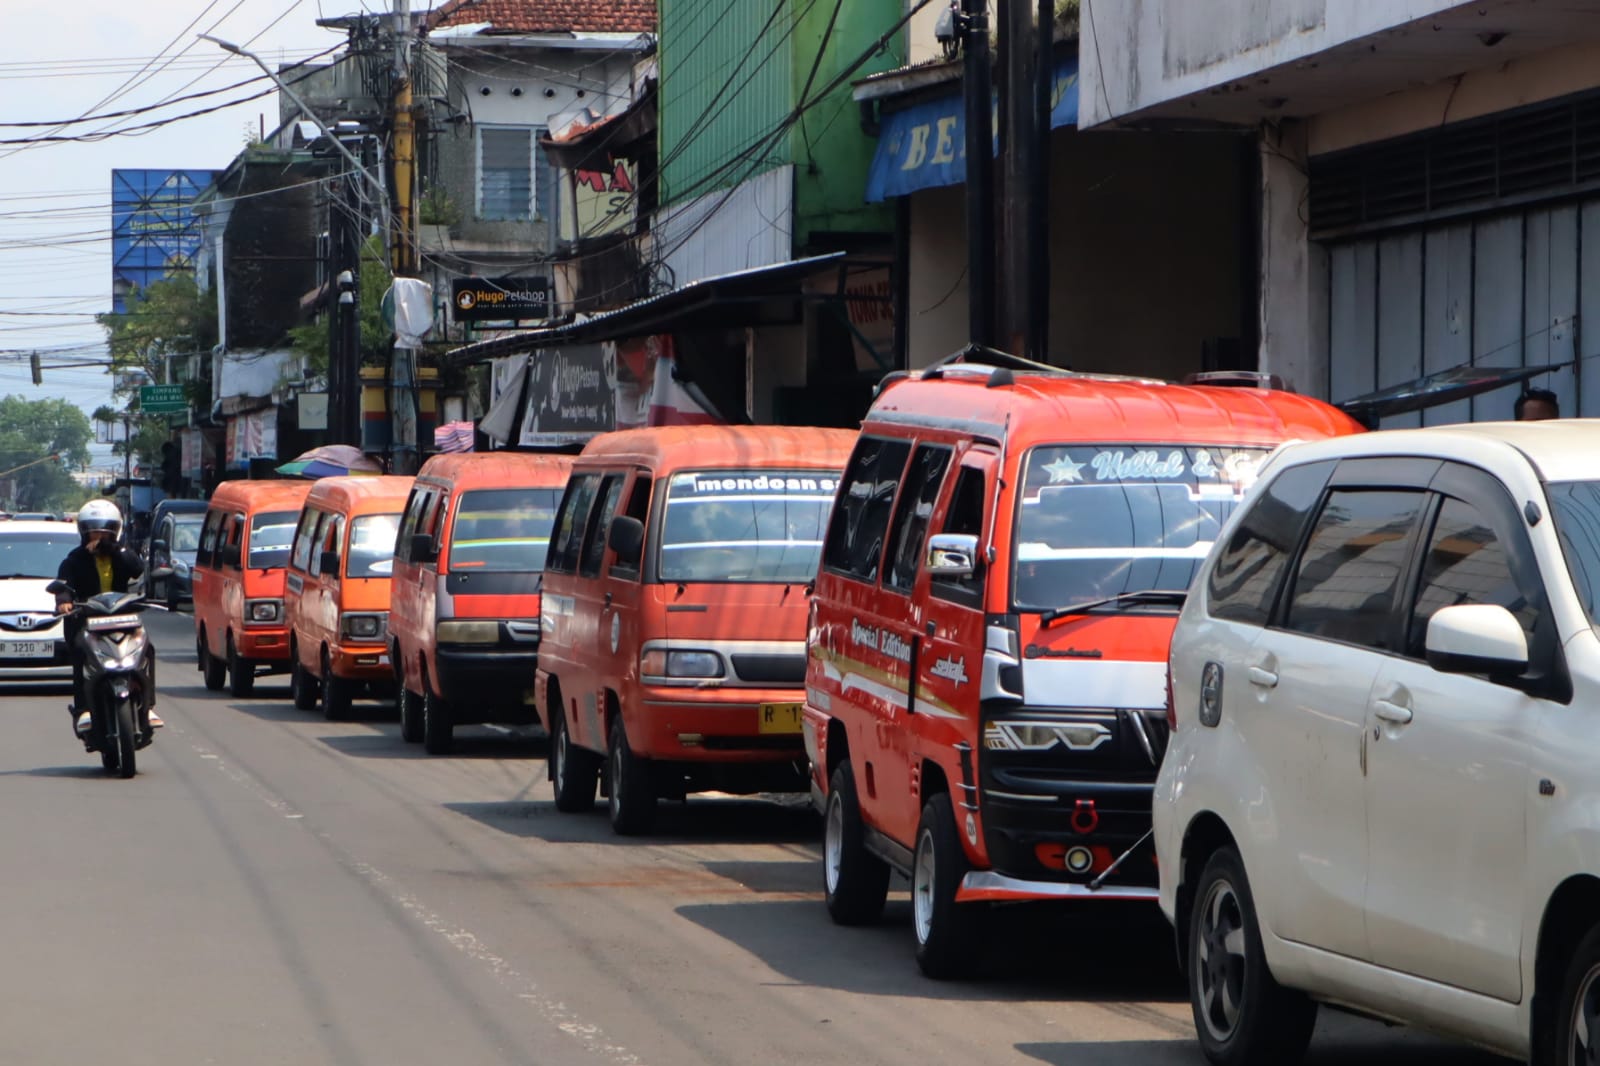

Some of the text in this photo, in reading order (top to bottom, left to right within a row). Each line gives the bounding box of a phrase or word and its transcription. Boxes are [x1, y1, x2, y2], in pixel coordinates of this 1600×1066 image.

[1191, 449, 1219, 478] &
[698, 475, 817, 491] mendoan
[851, 617, 911, 662] Special Edition
[764, 705, 803, 723] R 1
